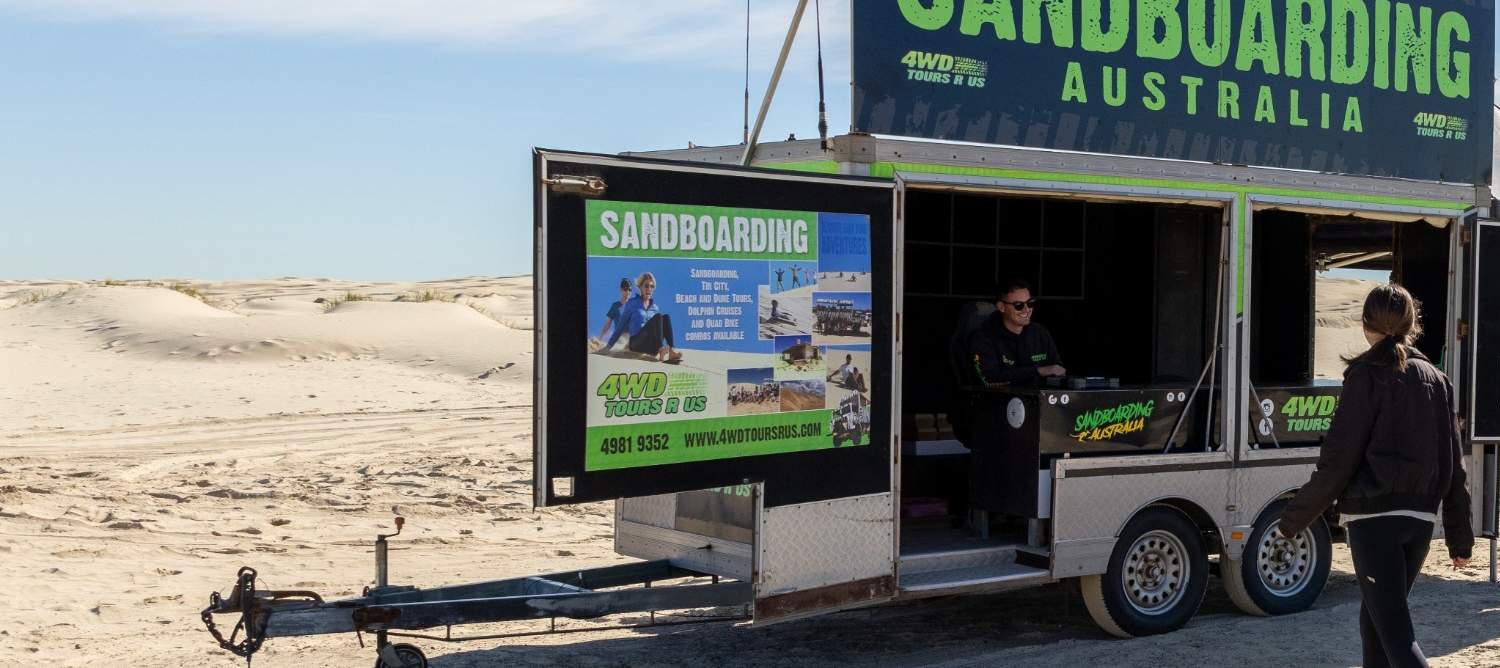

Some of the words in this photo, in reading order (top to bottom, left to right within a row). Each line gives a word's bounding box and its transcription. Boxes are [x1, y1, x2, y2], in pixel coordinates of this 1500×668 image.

[901, 50, 954, 72] 4WD
[907, 69, 950, 83] TOURS
[953, 73, 964, 86] R
[967, 76, 986, 88] US
[1061, 61, 1363, 133] AUSTRALIA
[1413, 112, 1447, 129] 4WD
[1417, 127, 1444, 138] TOURS
[1445, 130, 1453, 139] R
[1455, 131, 1467, 140] US
[600, 210, 808, 254] SANDBOARDING
[597, 372, 667, 400] 4WD
[604, 399, 663, 418] TOURS
[665, 397, 679, 414] R
[683, 396, 707, 412] US
[1075, 399, 1155, 433] SANDBOARDING
[1281, 395, 1336, 417] 4WD
[1088, 417, 1145, 441] AUSTRALIA
[1287, 418, 1331, 432] TOURS
[601, 436, 632, 455] 4981
[637, 433, 669, 452] 9352
[684, 422, 821, 448] WWW.4WDTOURSRUS.COM
